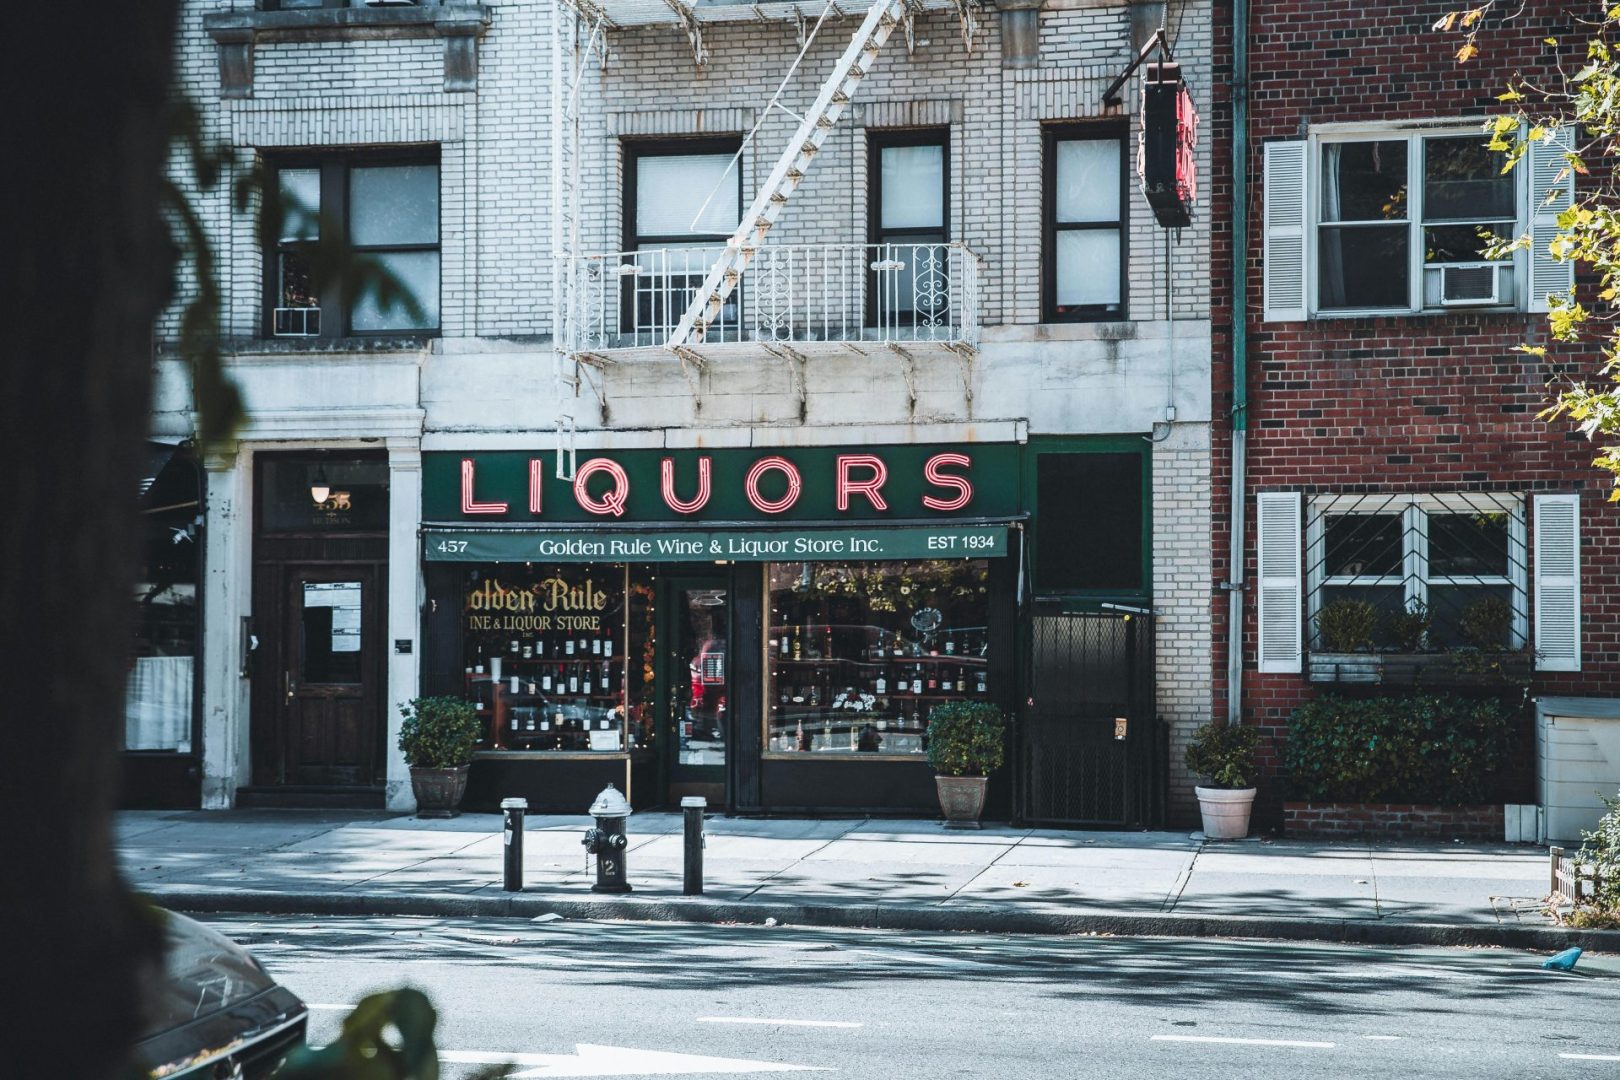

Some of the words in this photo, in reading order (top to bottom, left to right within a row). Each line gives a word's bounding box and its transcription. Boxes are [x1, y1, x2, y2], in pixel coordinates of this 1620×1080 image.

[461, 453, 974, 516] LIQUORS
[437, 540, 469, 554] 457
[539, 538, 605, 556] Golden
[610, 538, 652, 556] Rule
[657, 537, 703, 555] Wine
[708, 539, 723, 555] &
[728, 536, 789, 556] Liquor
[794, 536, 844, 554] Store
[850, 536, 884, 553] Inc.
[927, 535, 957, 551] EST
[962, 535, 995, 550] 1934
[470, 578, 536, 613] olden
[543, 578, 607, 612] Rule
[469, 615, 491, 630] INE
[493, 618, 501, 630] &
[504, 615, 551, 633] LIQUOR
[556, 615, 600, 630] STORE
